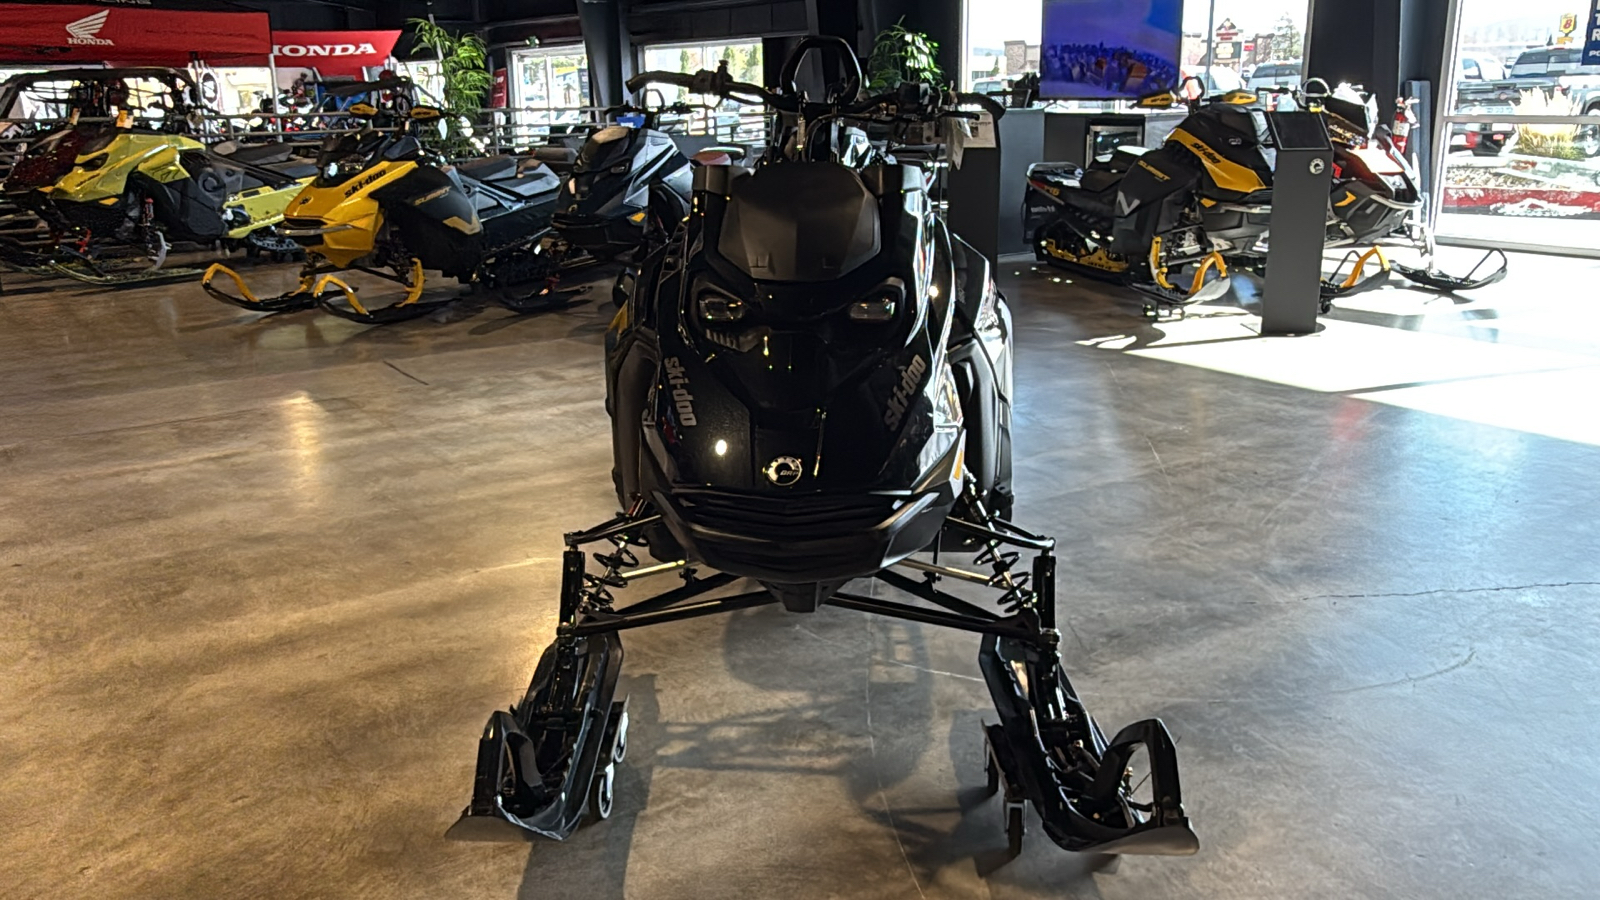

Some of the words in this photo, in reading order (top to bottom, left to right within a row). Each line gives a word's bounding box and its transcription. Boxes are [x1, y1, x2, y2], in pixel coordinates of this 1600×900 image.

[67, 37, 115, 46] HONDA
[344, 169, 387, 198] ski-doo
[664, 356, 698, 427] ski-doo
[884, 354, 927, 431] ski-doo
